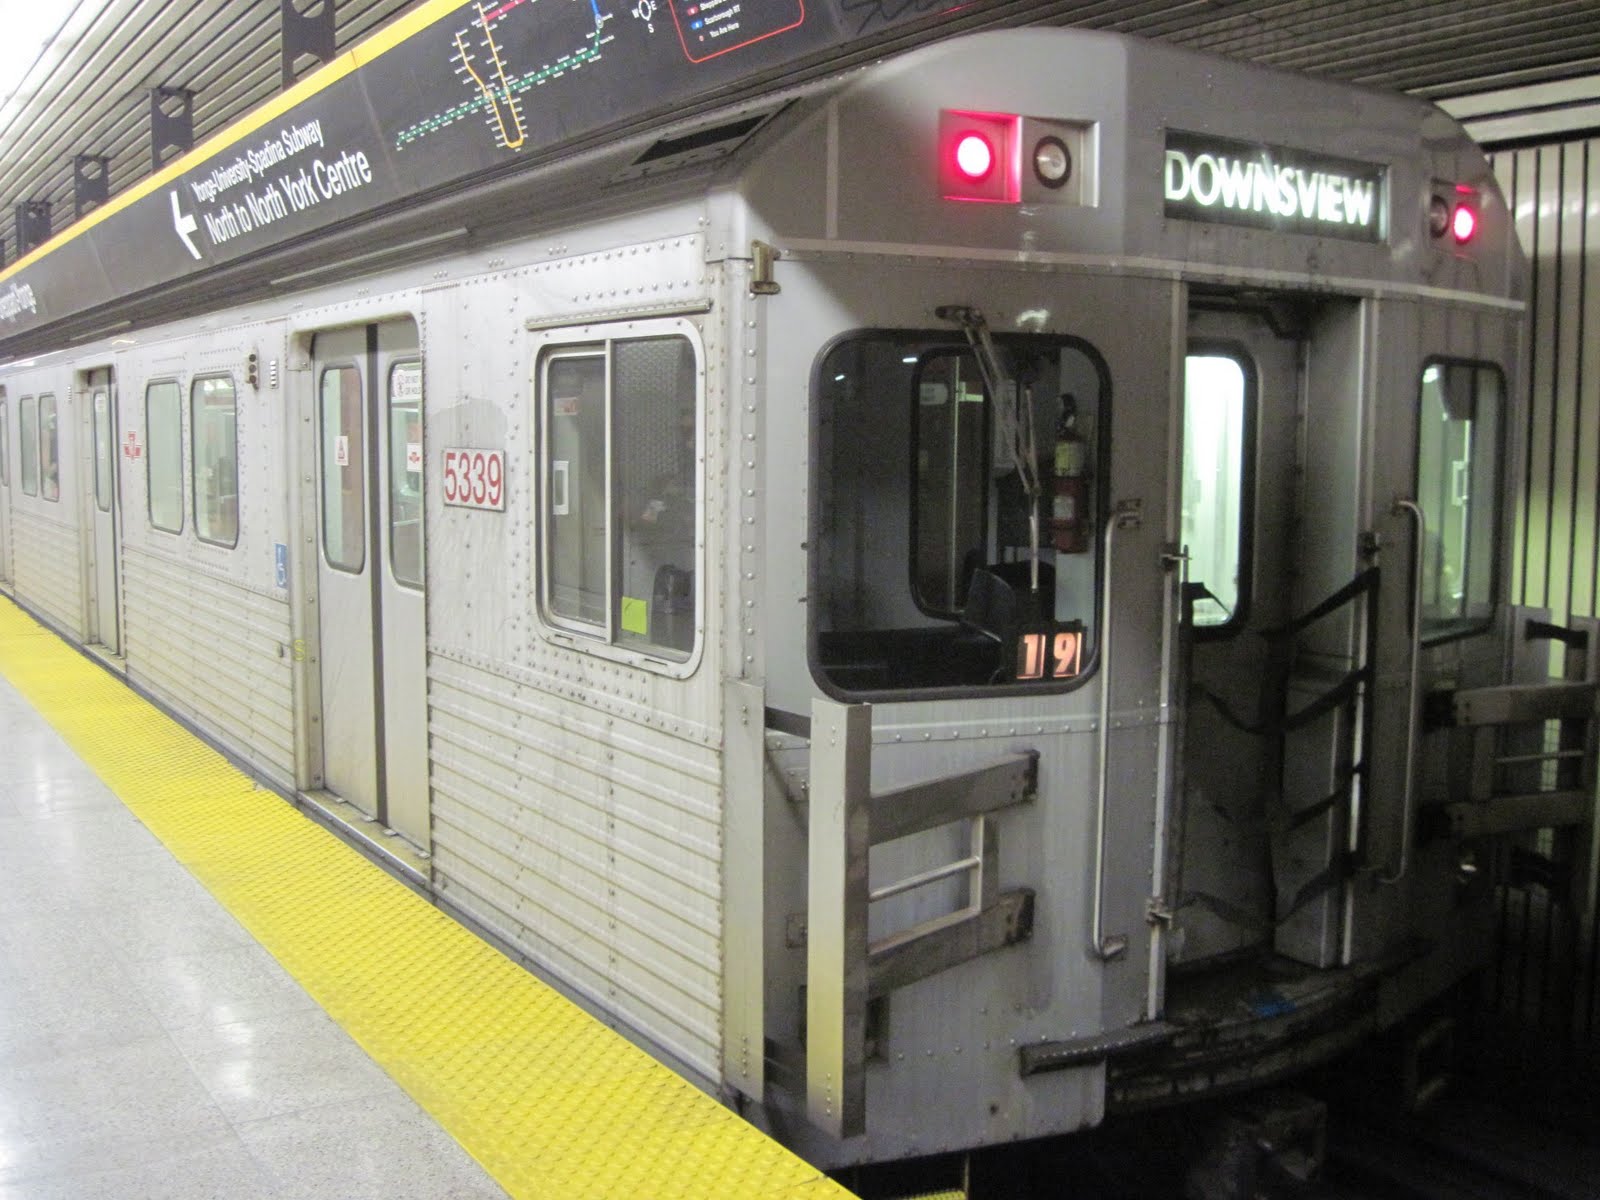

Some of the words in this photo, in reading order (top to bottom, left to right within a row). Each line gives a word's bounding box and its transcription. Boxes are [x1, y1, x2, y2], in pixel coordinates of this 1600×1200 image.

[281, 119, 324, 156] Subway
[203, 203, 240, 245] North
[233, 203, 252, 233] to
[245, 183, 288, 228] North
[279, 168, 320, 212] York
[313, 150, 372, 200] Centre
[1165, 150, 1373, 226] DOWNSVIEW
[445, 452, 502, 506] 5339
